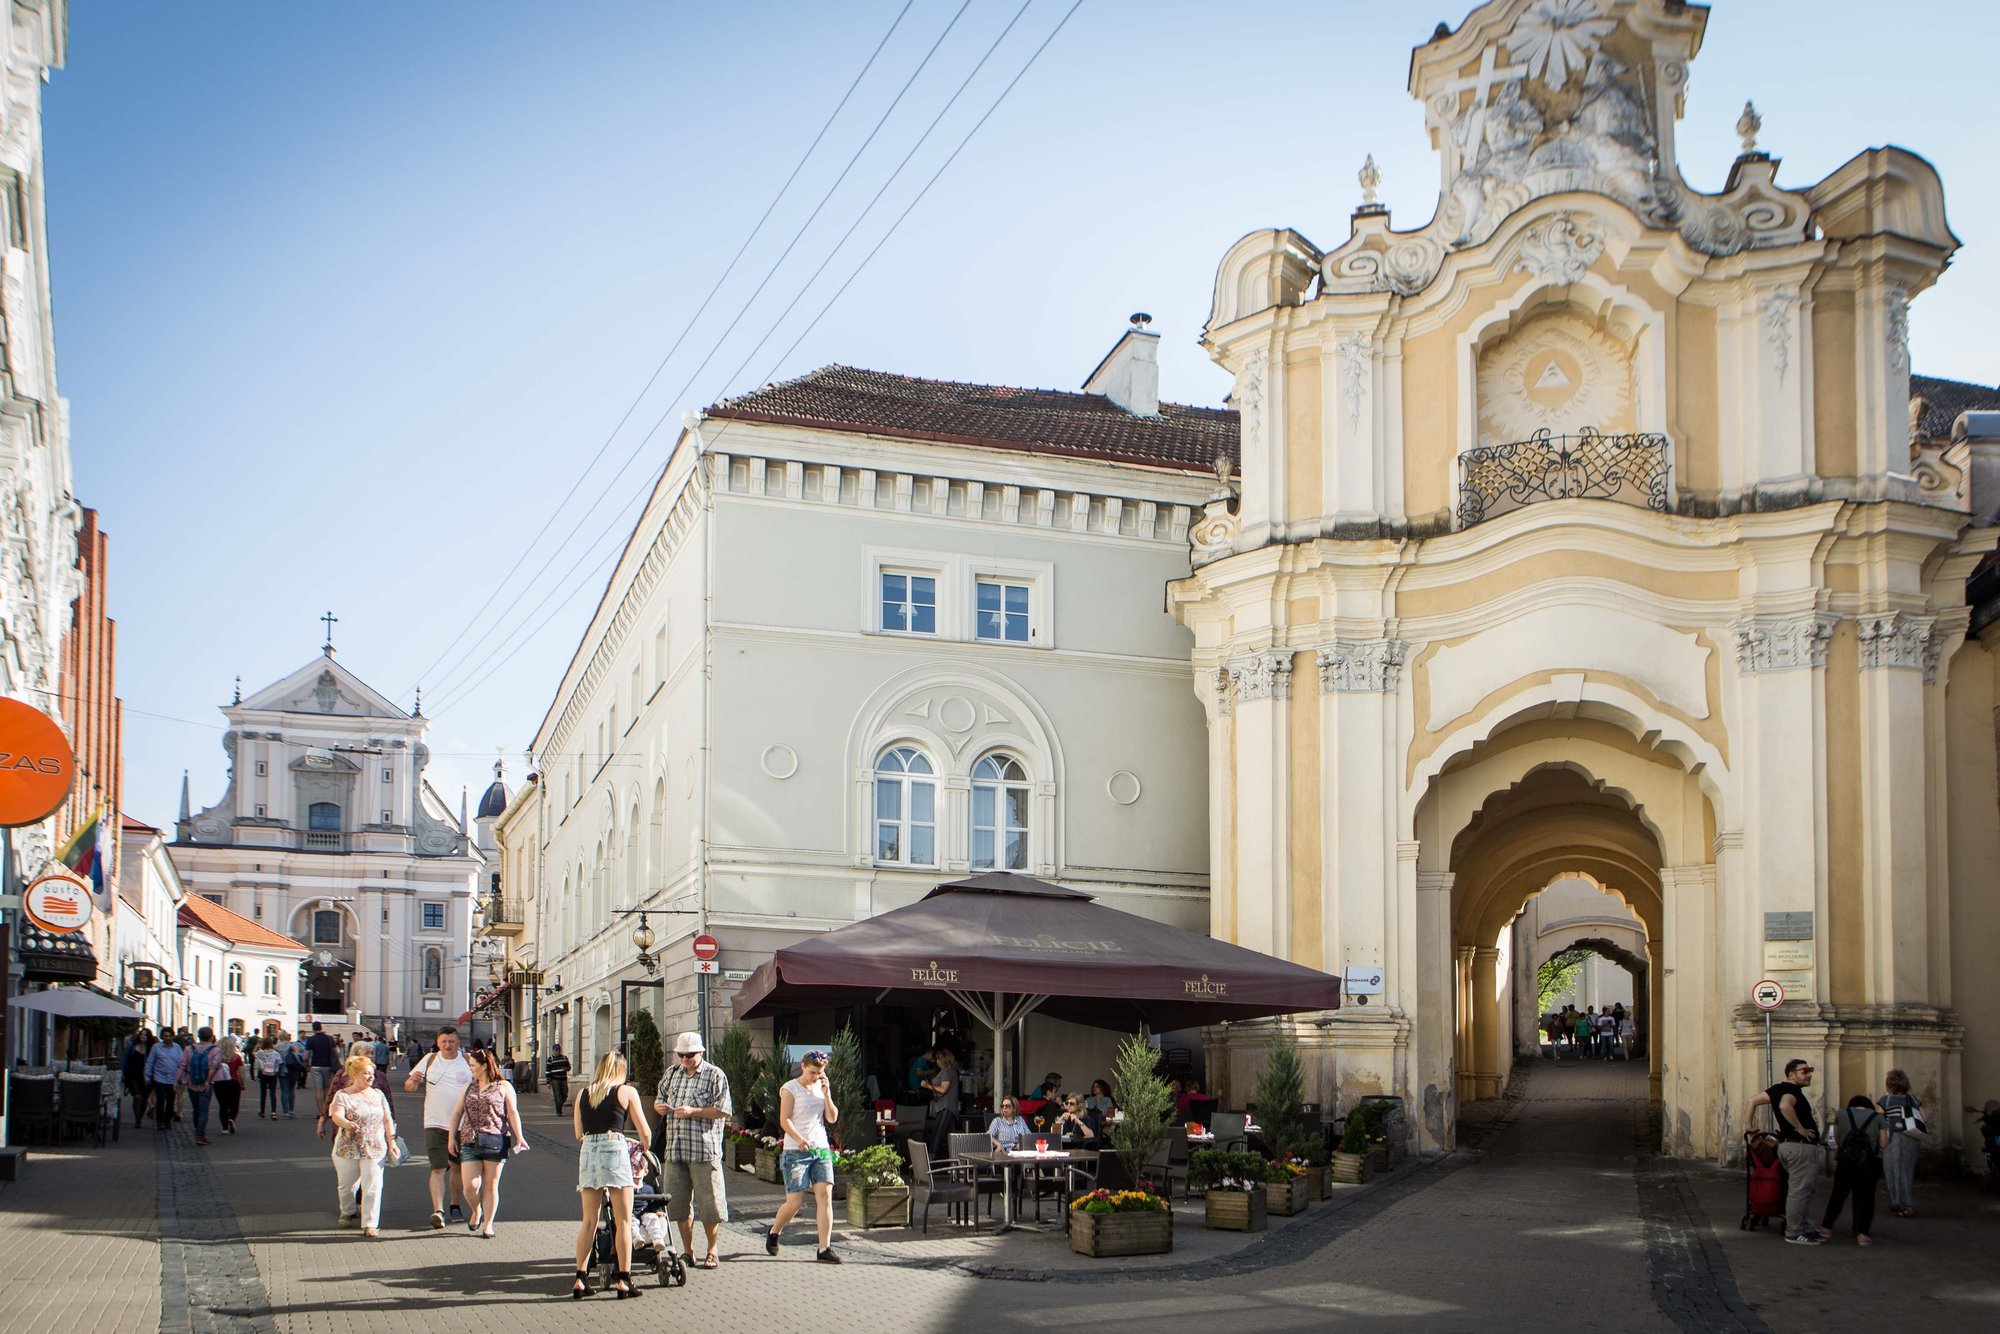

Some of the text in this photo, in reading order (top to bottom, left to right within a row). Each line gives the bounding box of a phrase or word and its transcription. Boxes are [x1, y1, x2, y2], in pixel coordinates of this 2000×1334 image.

[44, 882, 80, 896] Gusto
[990, 935, 1122, 951] FELICIE
[510, 968, 544, 985] amber
[911, 969, 958, 982] FELICIE
[1184, 981, 1227, 995] FELICIE
